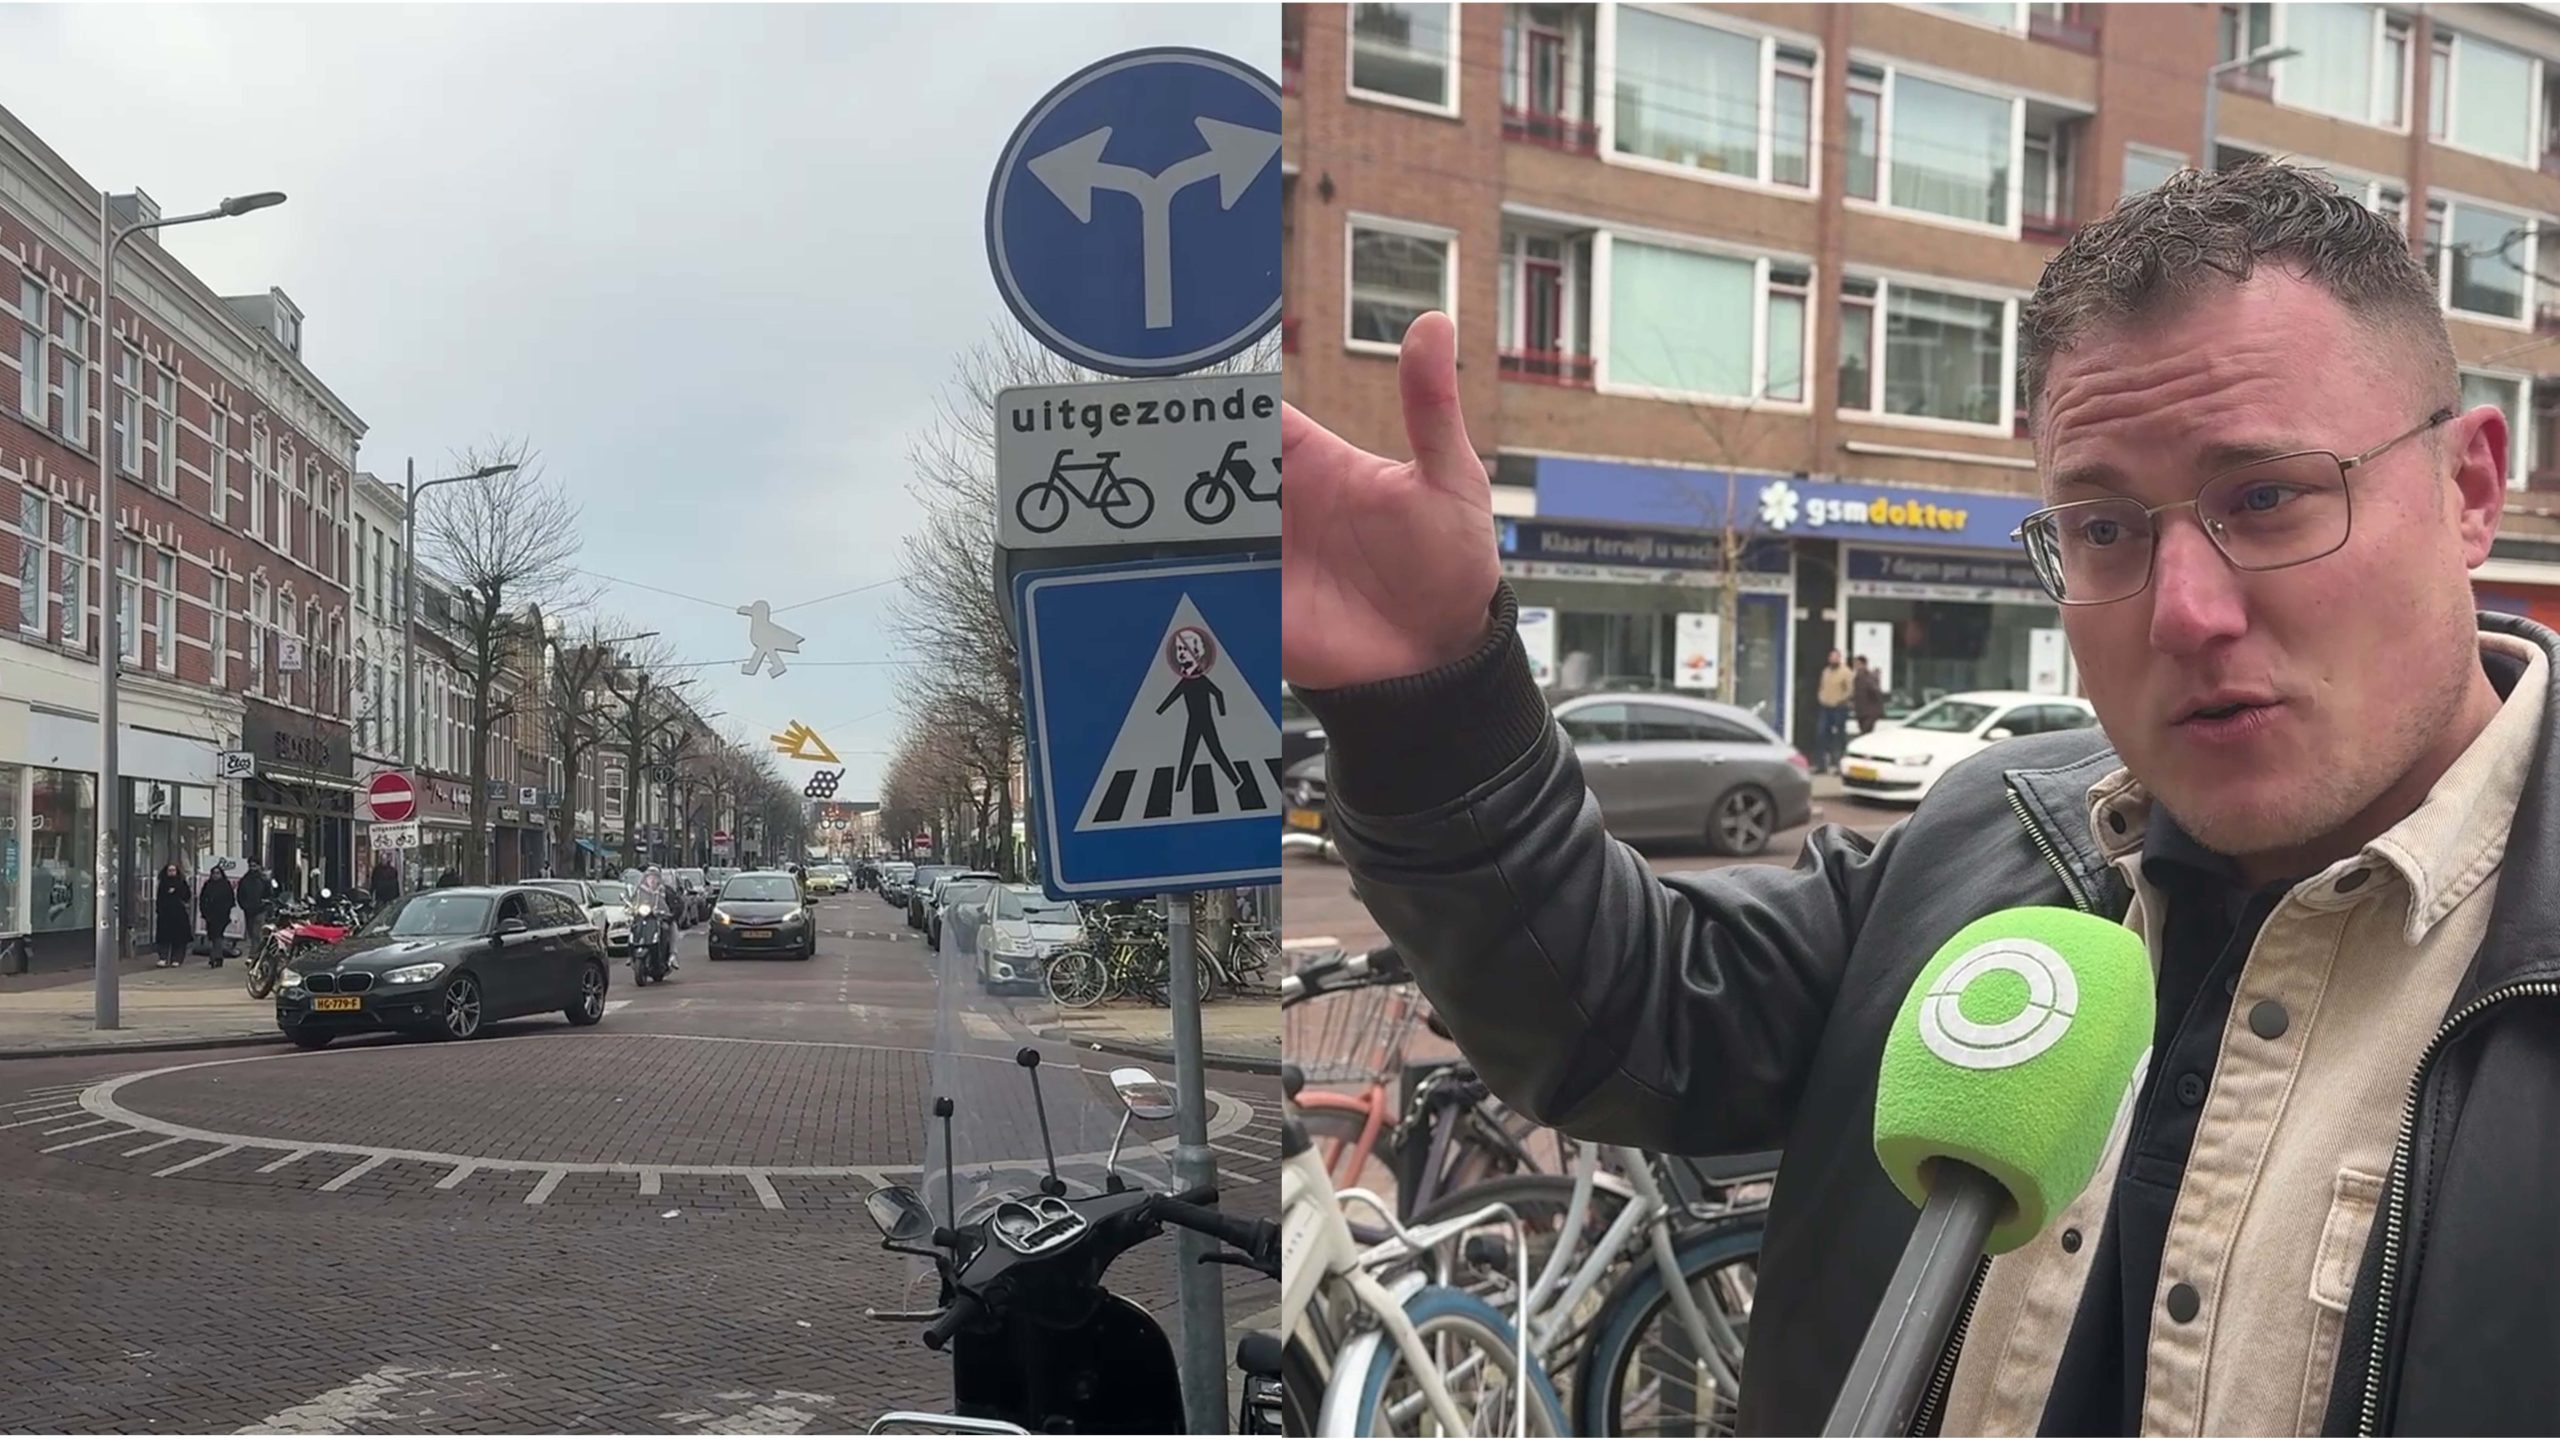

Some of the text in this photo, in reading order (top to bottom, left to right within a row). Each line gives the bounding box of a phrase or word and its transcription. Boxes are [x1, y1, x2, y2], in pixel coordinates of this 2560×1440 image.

[1012, 387, 1275, 438] uitgezonde
[1805, 496, 1968, 531] gsmdokter
[1540, 531, 1590, 554] Klaar
[1594, 535, 1653, 562] terwijl
[227, 754, 251, 769] Etos
